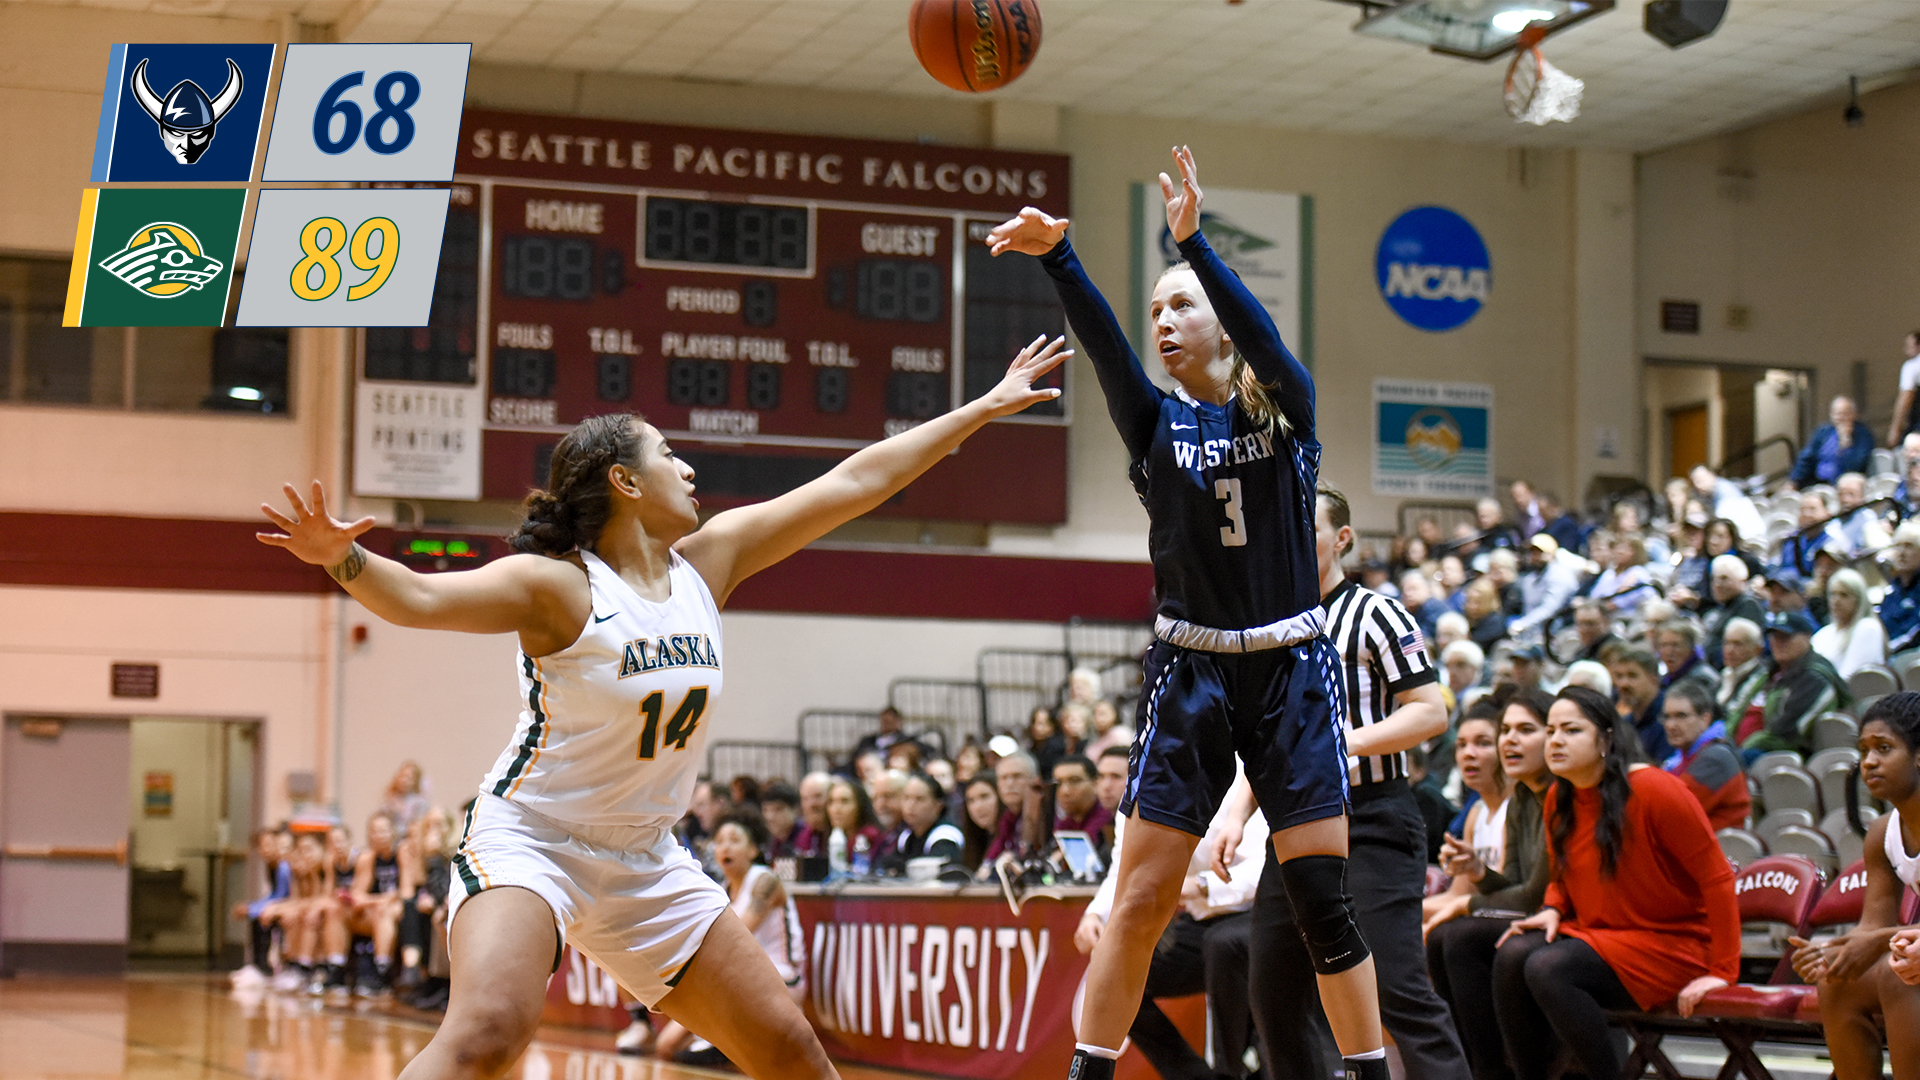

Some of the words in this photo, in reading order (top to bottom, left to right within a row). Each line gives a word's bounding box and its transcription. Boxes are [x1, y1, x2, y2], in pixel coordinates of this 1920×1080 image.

[472, 129, 651, 170] SEATTLE
[673, 144, 843, 185] PACIFIC
[863, 156, 1048, 199] FALCONS
[525, 200, 604, 233] HOME
[861, 222, 939, 256] GUEST
[1387, 262, 1488, 301] NCAA
[666, 286, 740, 314] PERIOD
[497, 322, 554, 350] FOULS
[661, 331, 737, 360] PLAYER
[738, 336, 791, 363] FOUL
[891, 346, 945, 373] FOULS
[489, 398, 557, 426] SCORE
[1173, 430, 1275, 472] WESTERN
[1214, 478, 1248, 547] 3
[617, 633, 720, 681] ALASKA
[636, 685, 709, 761] 14
[1735, 870, 1799, 895] FALCONS
[812, 921, 1050, 1053] UNIVERSITY
